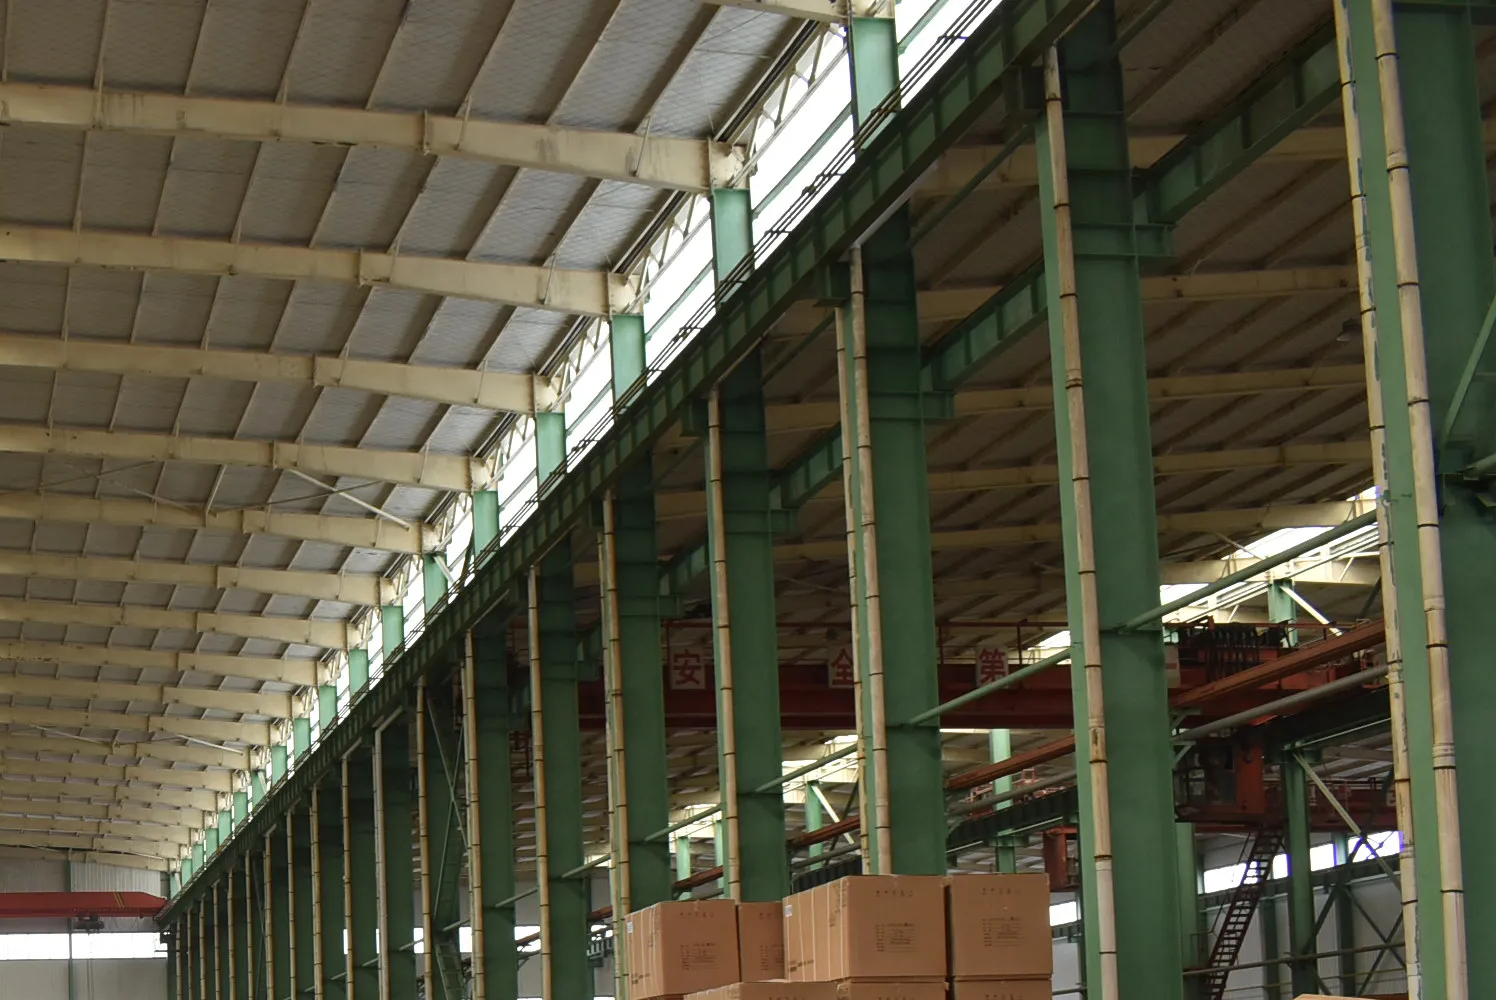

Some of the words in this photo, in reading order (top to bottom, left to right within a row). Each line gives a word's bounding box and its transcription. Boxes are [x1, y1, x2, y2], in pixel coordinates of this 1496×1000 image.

[673, 648, 702, 686] 安
[831, 647, 854, 686] 全
[978, 647, 1007, 685] 第
